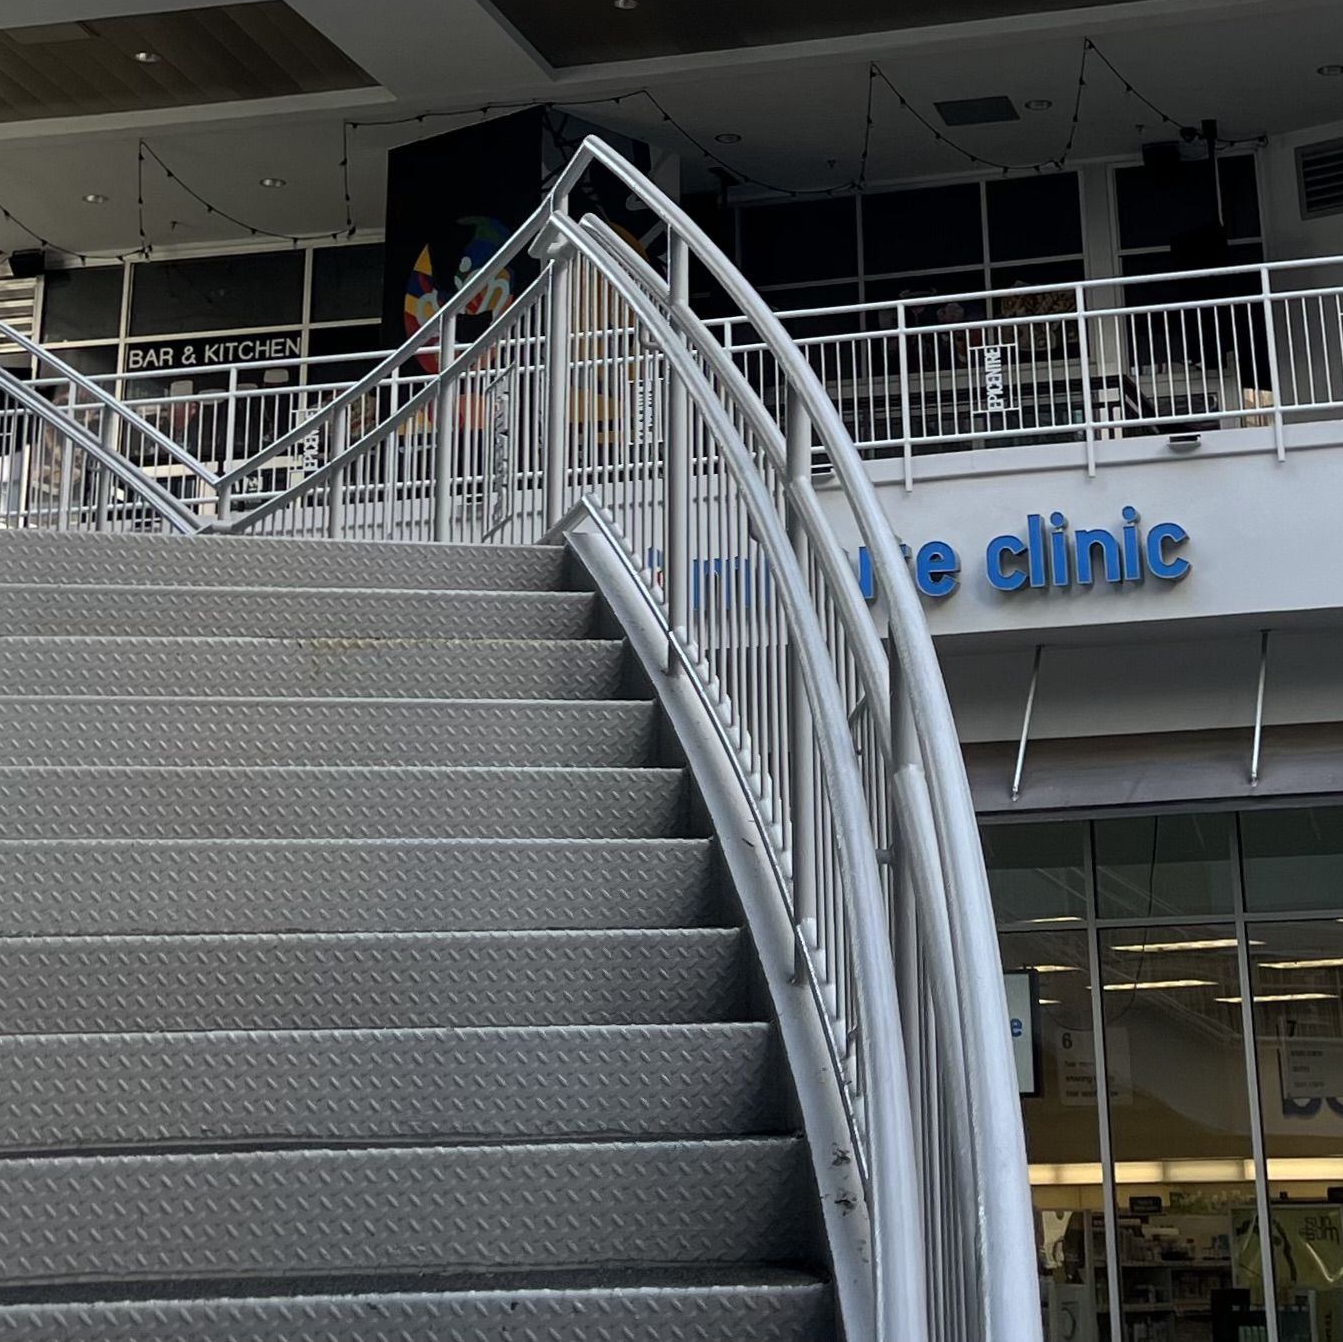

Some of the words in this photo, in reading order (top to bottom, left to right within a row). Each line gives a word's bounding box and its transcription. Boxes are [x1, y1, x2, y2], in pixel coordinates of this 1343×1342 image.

[129, 348, 174, 369] BAR
[182, 346, 196, 364] &
[204, 336, 302, 364] KITCHEN
[984, 345, 1004, 412] EPICENTRE
[986, 506, 1191, 592] clinic
[1061, 1032, 1073, 1050] 6
[1286, 1020, 1297, 1037] 7
